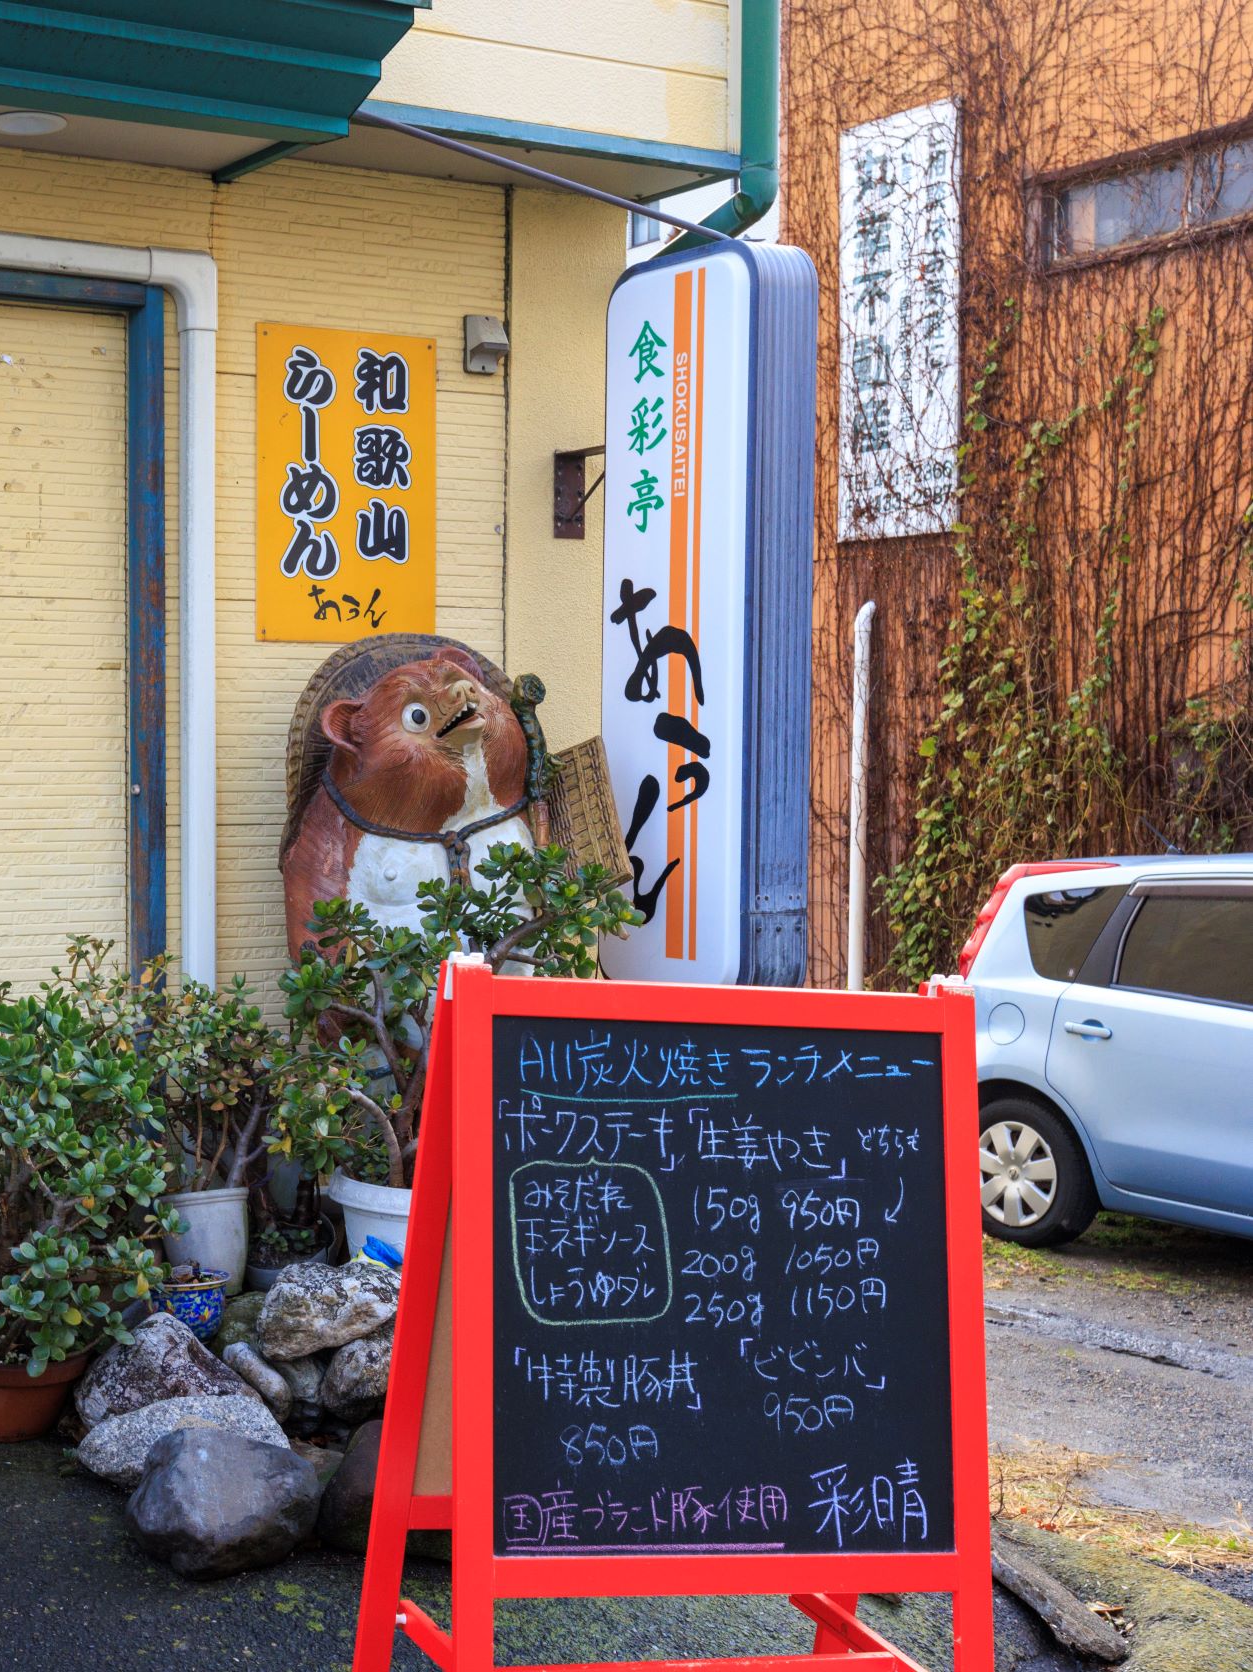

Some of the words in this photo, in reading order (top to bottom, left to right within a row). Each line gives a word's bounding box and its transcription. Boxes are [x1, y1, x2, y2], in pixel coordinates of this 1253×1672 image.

[626, 320, 668, 534] 食彩亭
[673, 352, 688, 498] SHOKUSAITEI
[282, 347, 338, 579] らーめん
[355, 349, 410, 563] 和歌山
[308, 584, 388, 628] あうん
[523, 1170, 633, 1213] みそだれ
[693, 1185, 761, 1235] 150g
[781, 1187, 861, 1232] 950円
[517, 1215, 655, 1258] 玉ネギソース
[681, 1246, 757, 1281] 200g
[784, 1238, 879, 1275] 1050円
[684, 1290, 764, 1326] 250g
[791, 1278, 887, 1317] 1150円
[764, 1392, 854, 1434] 950円
[560, 1423, 658, 1466] 850円
[503, 1480, 788, 1546] 国産ブランド豚使用
[808, 1457, 928, 1548] 彩晴
